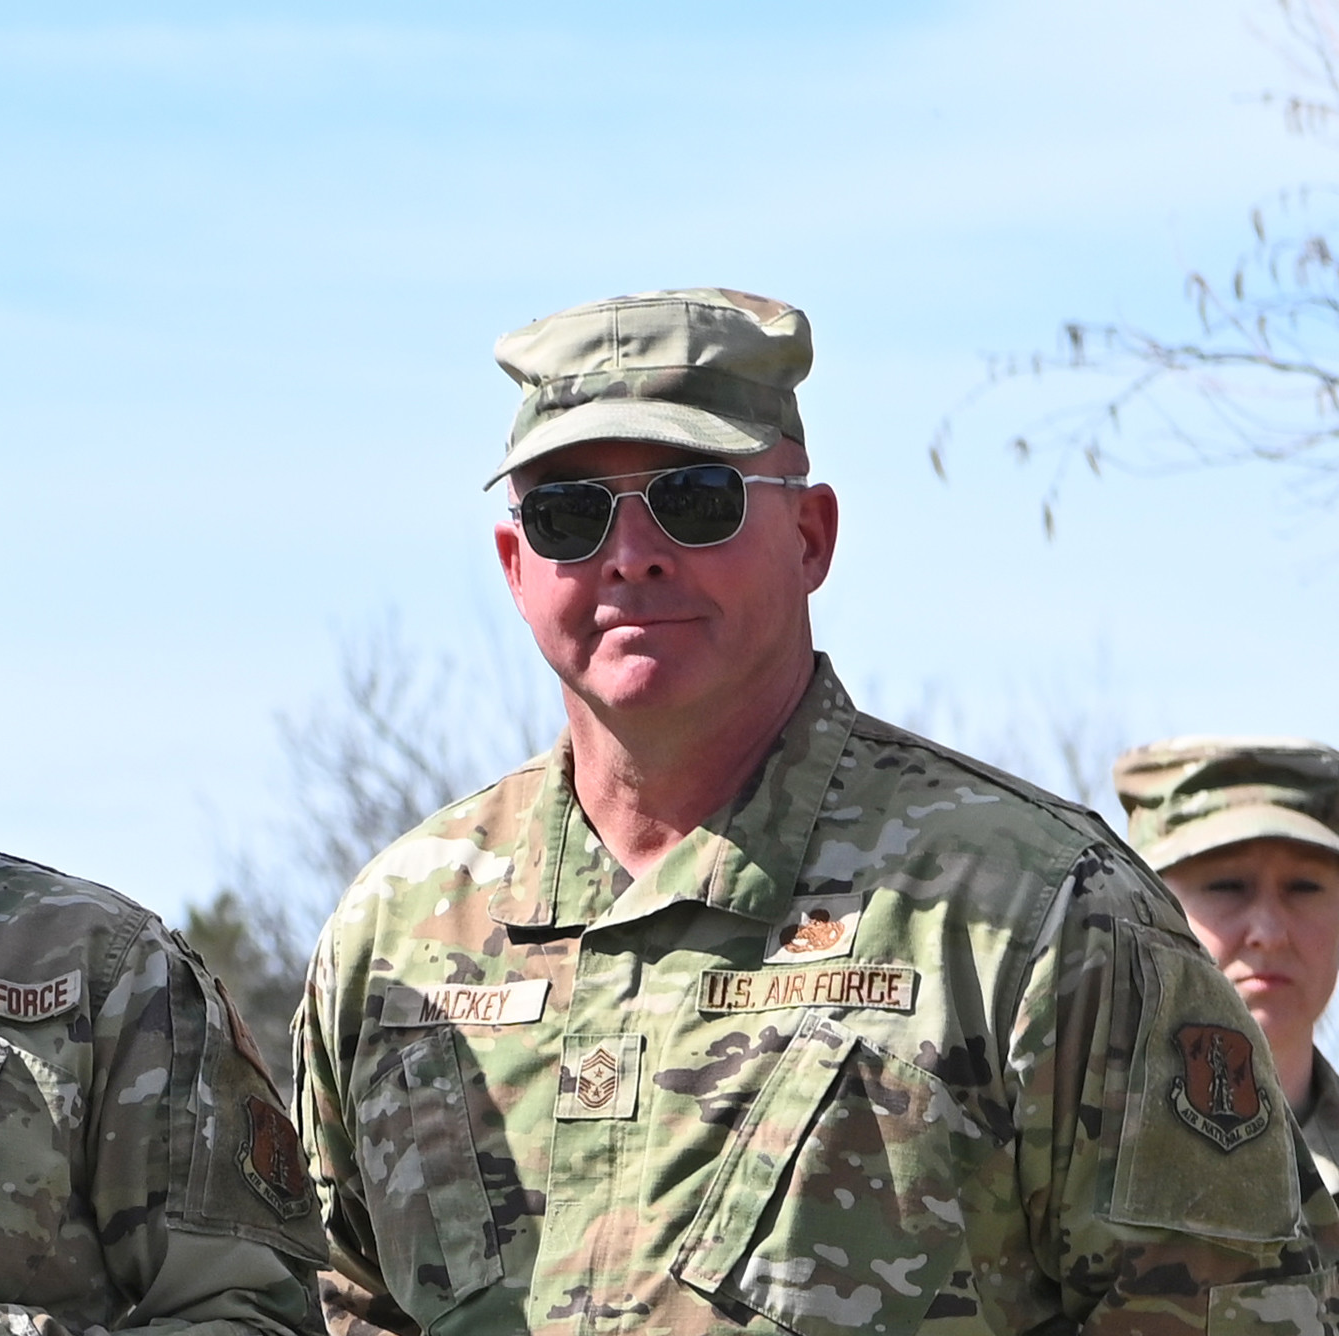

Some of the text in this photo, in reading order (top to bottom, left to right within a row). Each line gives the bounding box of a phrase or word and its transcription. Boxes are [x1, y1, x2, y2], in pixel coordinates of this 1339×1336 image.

[419, 989, 511, 1022] MACKEY
[707, 971, 901, 1009] U.S. AIR FORCE
[1182, 1108, 1199, 1125] AIR
